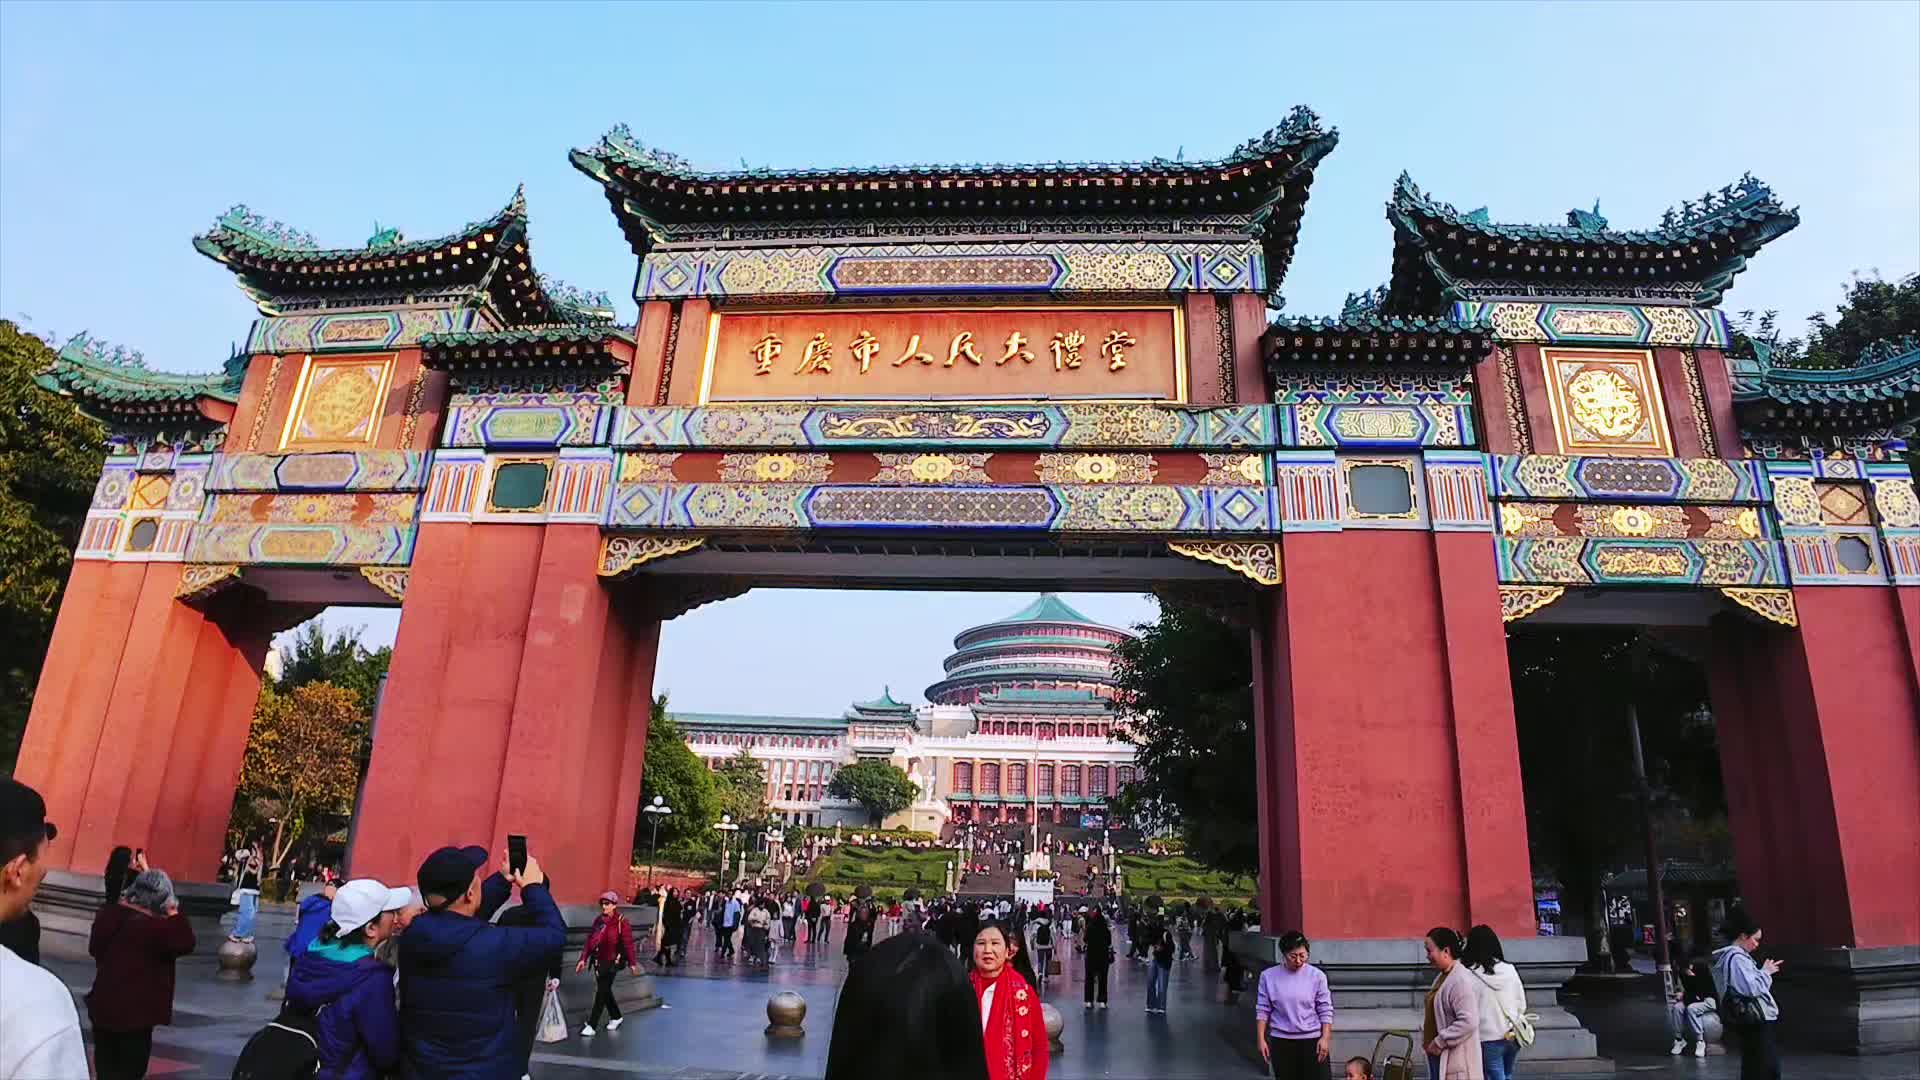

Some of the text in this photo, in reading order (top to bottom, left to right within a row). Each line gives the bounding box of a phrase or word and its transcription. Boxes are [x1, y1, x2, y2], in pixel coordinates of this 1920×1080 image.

[751, 330, 1136, 375] 重慶市人民大禮堂
